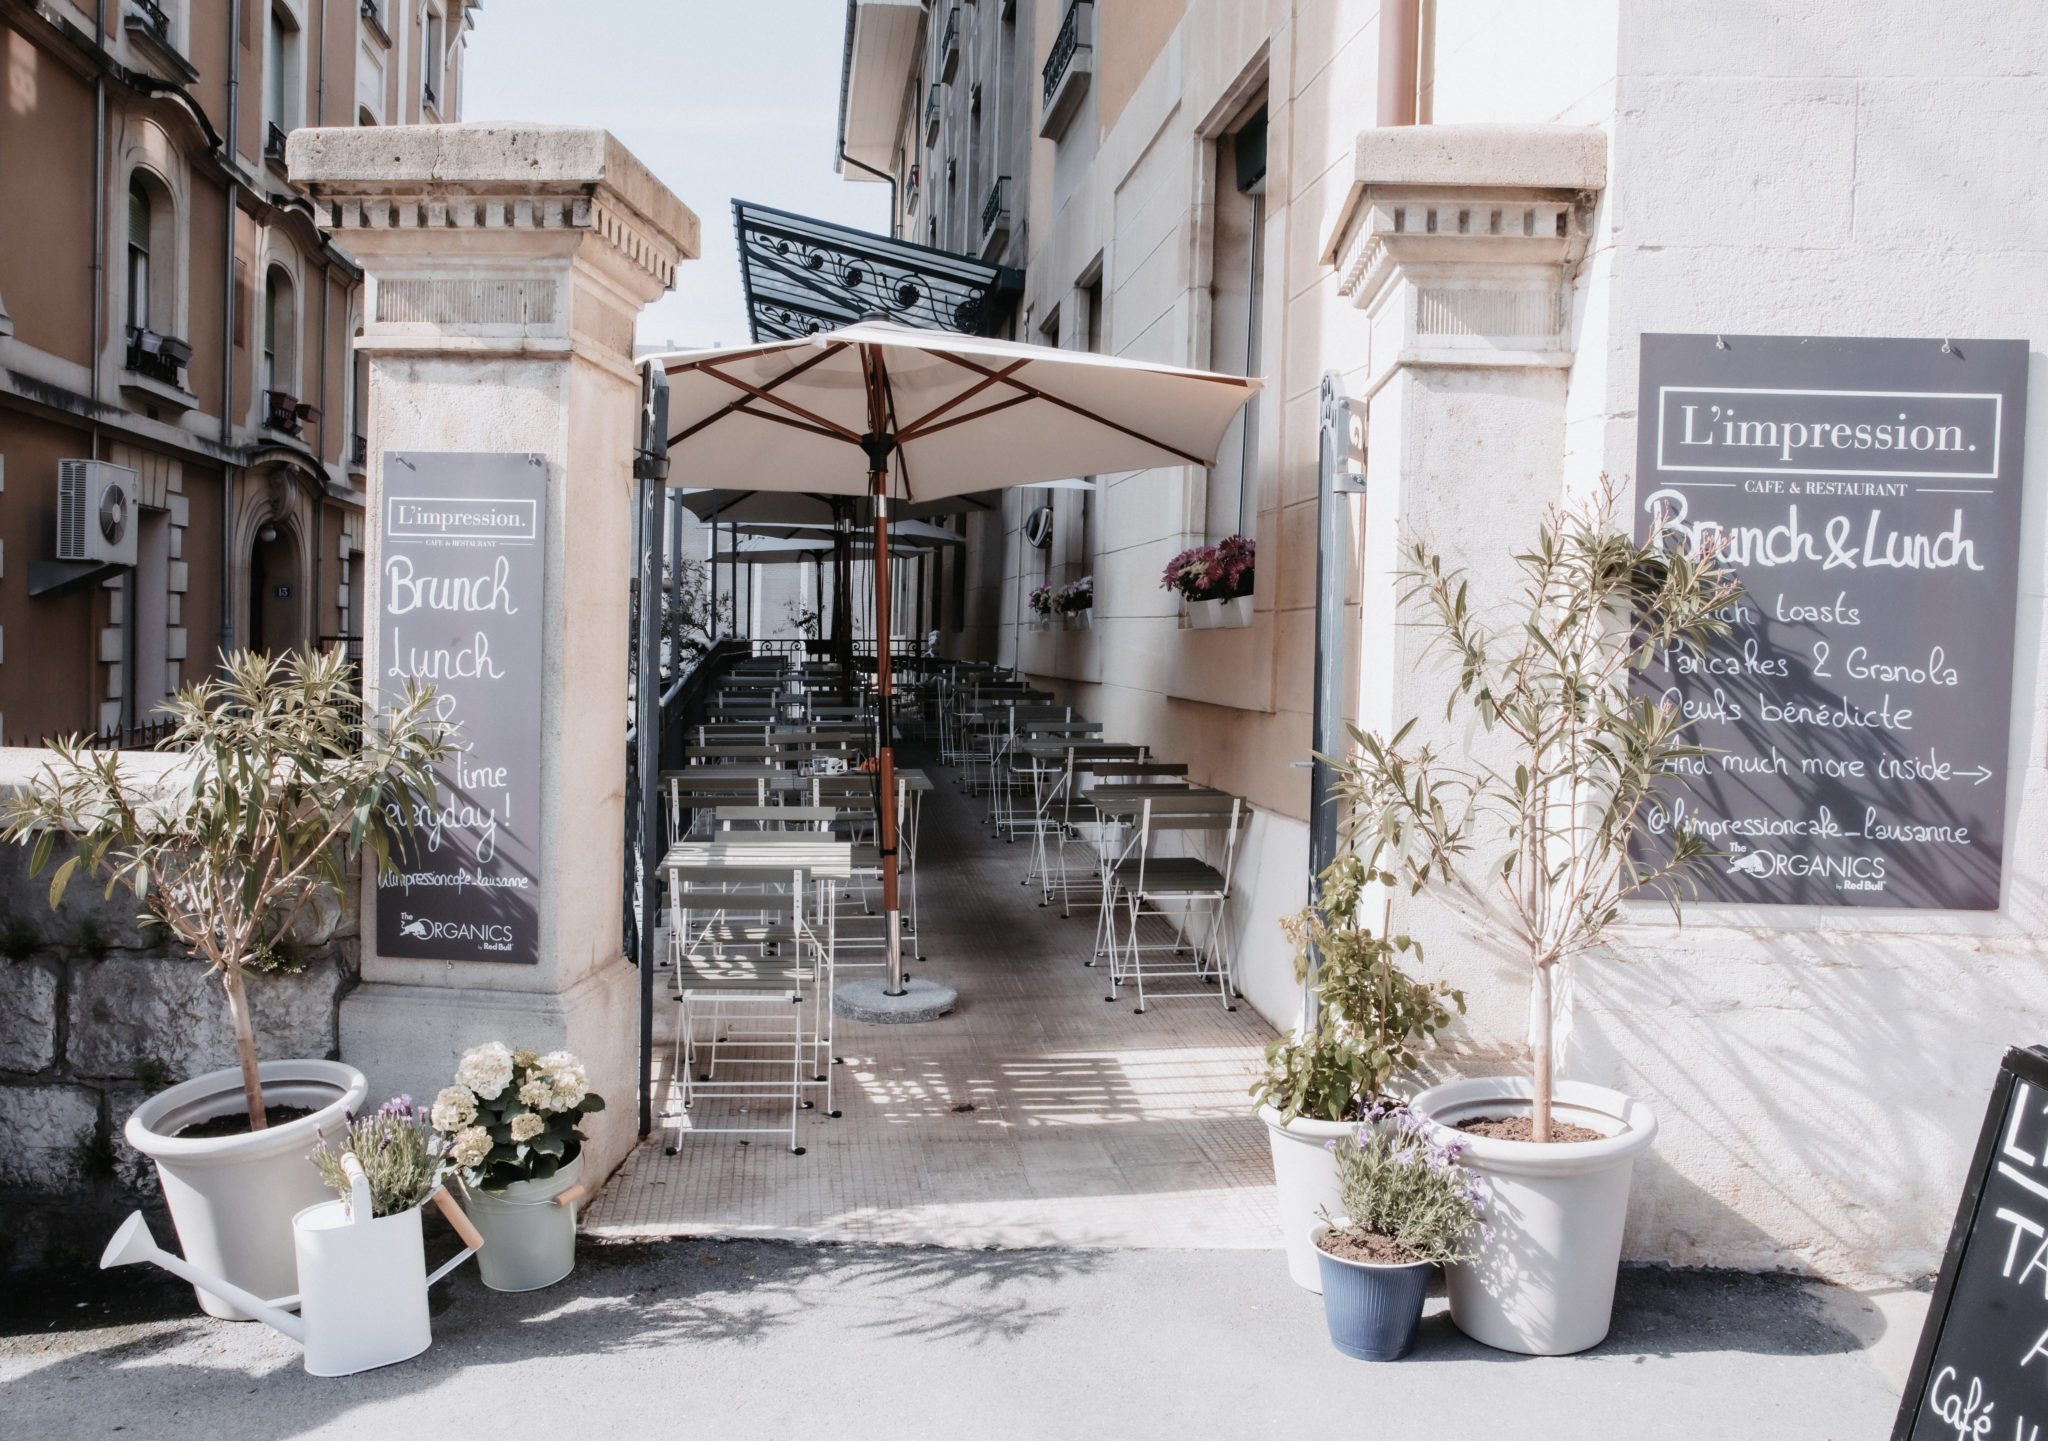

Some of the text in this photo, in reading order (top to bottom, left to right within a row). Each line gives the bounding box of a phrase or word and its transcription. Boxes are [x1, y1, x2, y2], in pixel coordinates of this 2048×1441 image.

[1680, 405, 1976, 461] L'impression.
[1744, 479, 1908, 497] CAFE & RESTAURANT
[398, 505, 526, 531] L'impression.
[425, 539, 443, 547] CAFE
[452, 539, 497, 548] RESTAURANT
[386, 554, 519, 615] Brunch
[1776, 591, 1861, 625] toasts
[388, 626, 506, 680] Lunch
[1660, 638, 1789, 677] Pancakes
[1846, 645, 1958, 686] Granola
[436, 693, 465, 737] &
[1660, 686, 1913, 730] Oeufs bénédicte
[1721, 746, 1788, 776] much
[1801, 756, 1865, 778] more
[1879, 746, 1951, 781] inside
[1729, 841, 1747, 853] The
[1749, 849, 1886, 879] ORGANICS
[1844, 879, 1863, 891] Red
[1864, 880, 1884, 891] Bull
[401, 911, 414, 921] The
[415, 918, 513, 942] ORGANICS
[484, 942, 498, 950] Red
[498, 943, 512, 951] Bull
